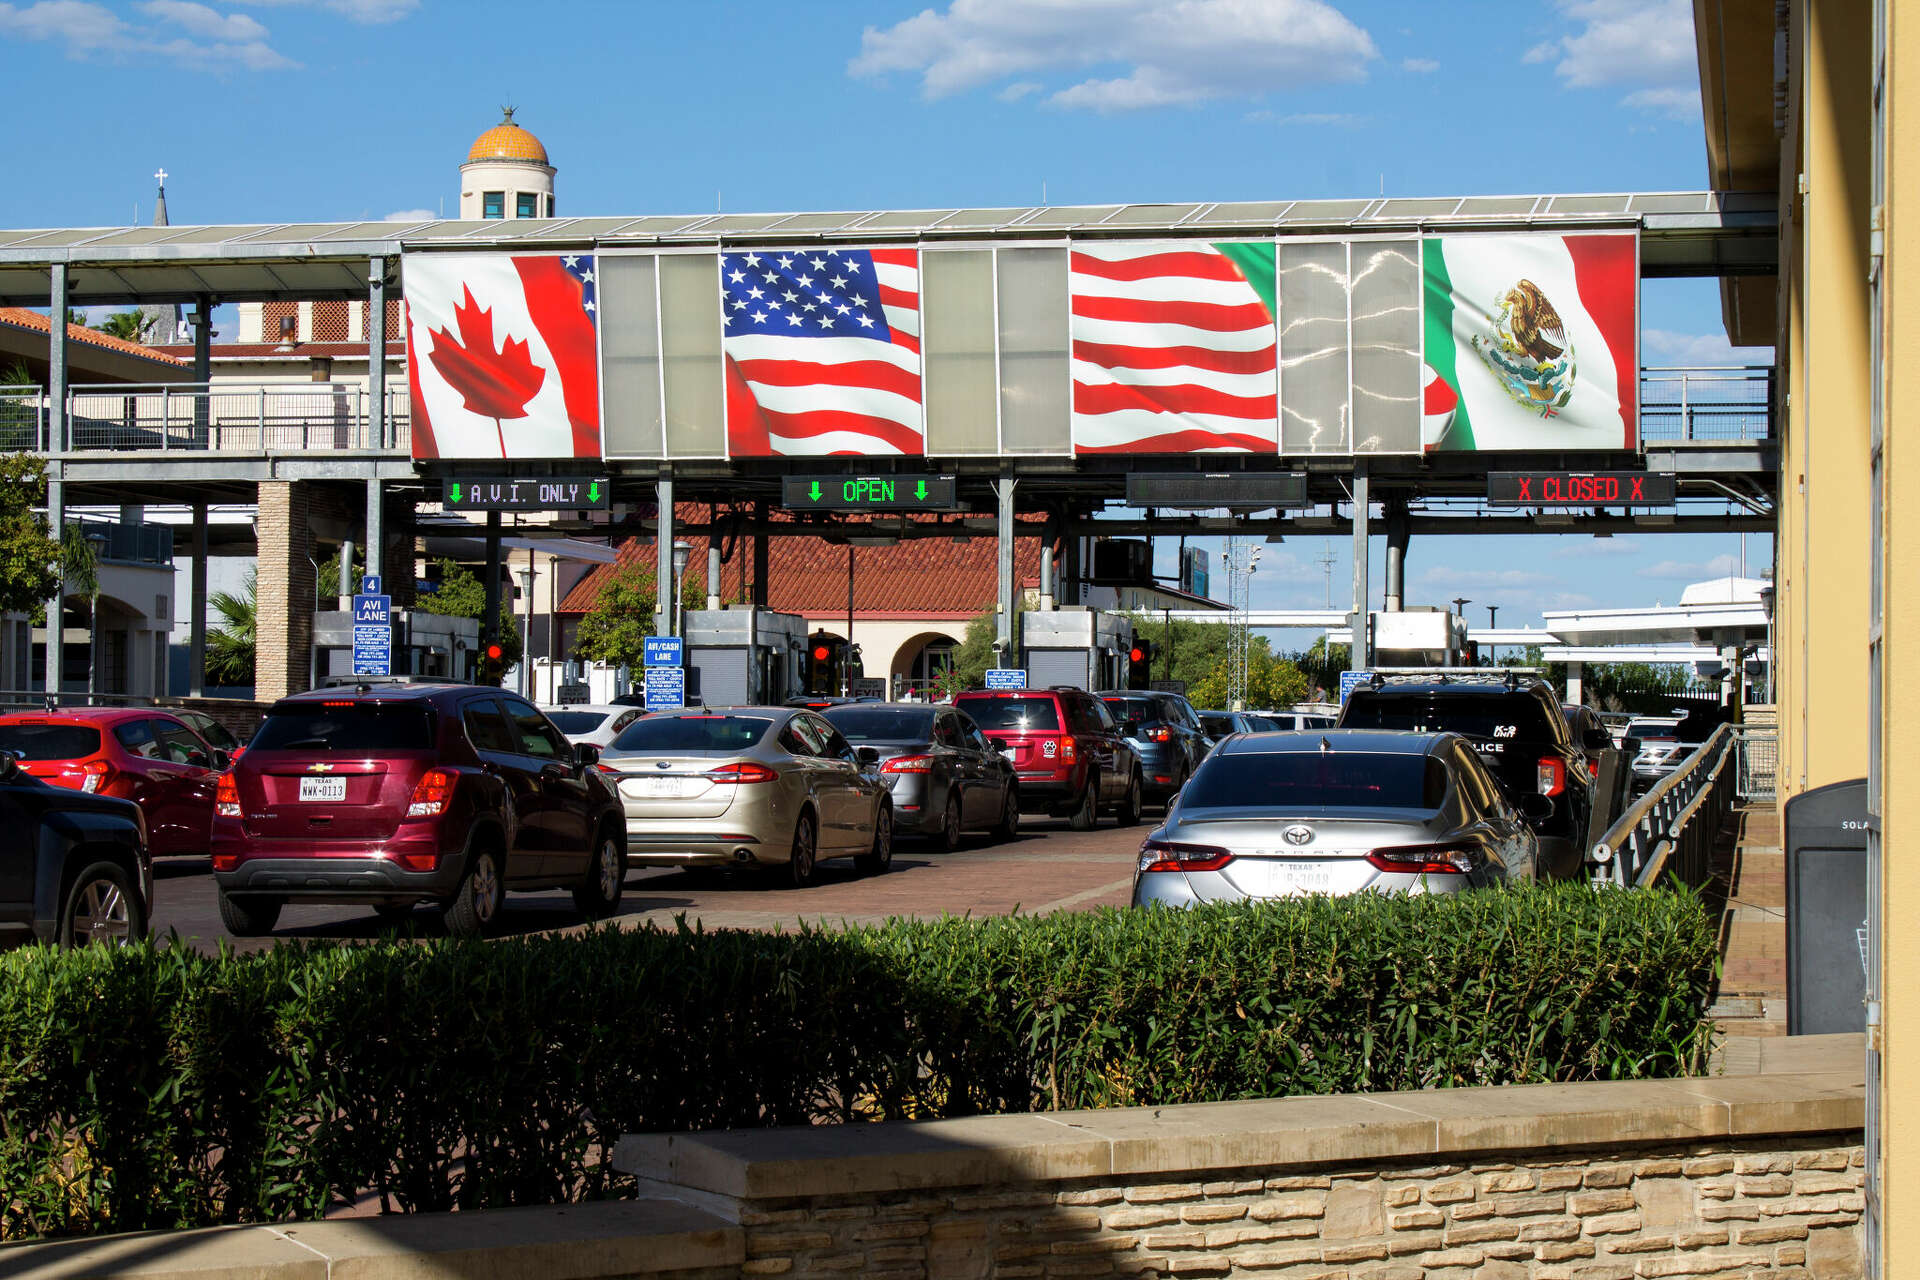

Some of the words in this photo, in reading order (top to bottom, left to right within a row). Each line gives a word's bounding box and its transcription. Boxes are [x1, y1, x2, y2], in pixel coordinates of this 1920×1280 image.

[470, 484, 526, 503] A.V.I.
[539, 484, 578, 503] ONLY
[843, 481, 895, 502] OPEN
[1543, 477, 1618, 501] CLOSED
[367, 579, 376, 590] 4
[363, 600, 381, 610] AVI
[356, 611, 387, 621] LANE
[647, 642, 680, 652] AVI/CASH
[654, 653, 672, 661] LANE
[1472, 743, 1504, 752] LICE
[1842, 821, 1869, 829] SOLA
